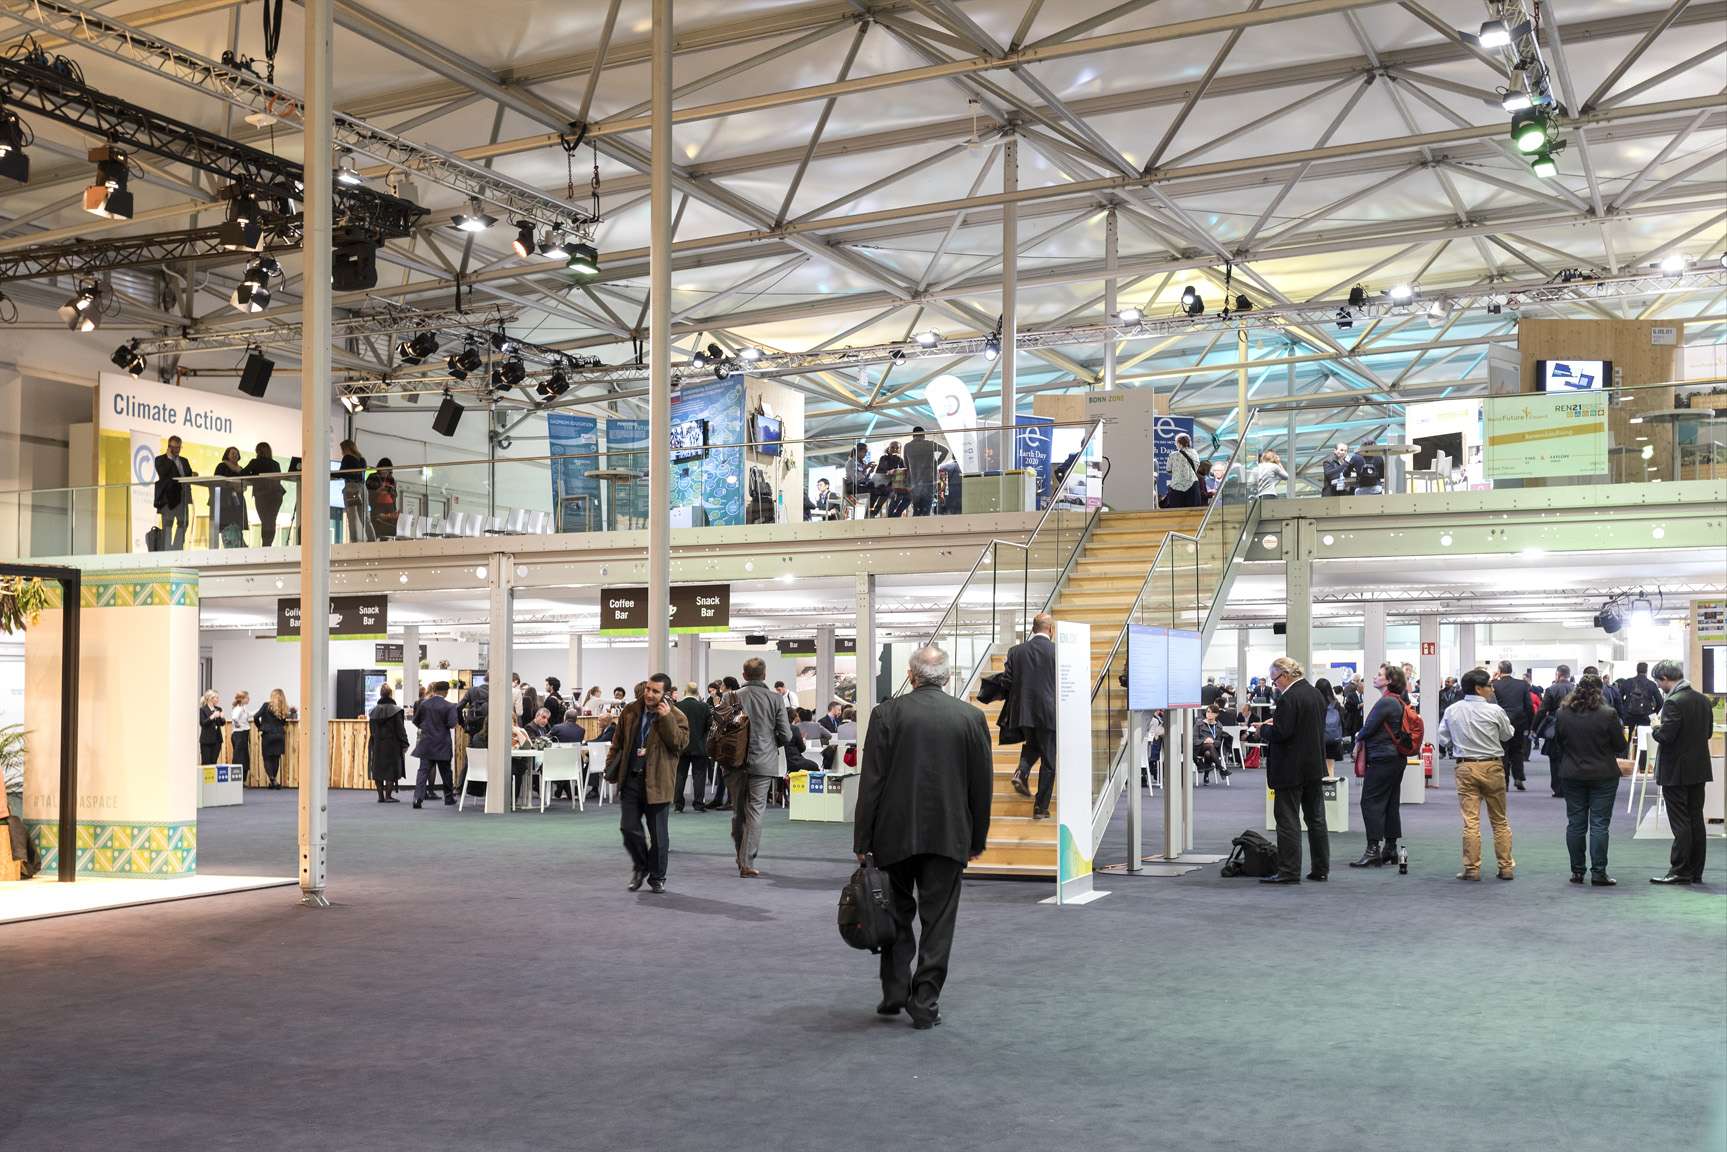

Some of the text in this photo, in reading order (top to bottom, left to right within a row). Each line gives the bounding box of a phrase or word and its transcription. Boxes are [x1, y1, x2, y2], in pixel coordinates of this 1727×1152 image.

[113, 393, 232, 433] Climate Action
[1554, 404, 1582, 412] REN21
[609, 598, 634, 609] Coffee
[696, 595, 721, 606] Snack
[285, 607, 301, 617] Coff
[359, 605, 379, 615] Snack
[615, 610, 628, 619] Bar
[701, 607, 715, 617] Bar
[363, 616, 375, 626] Bar
